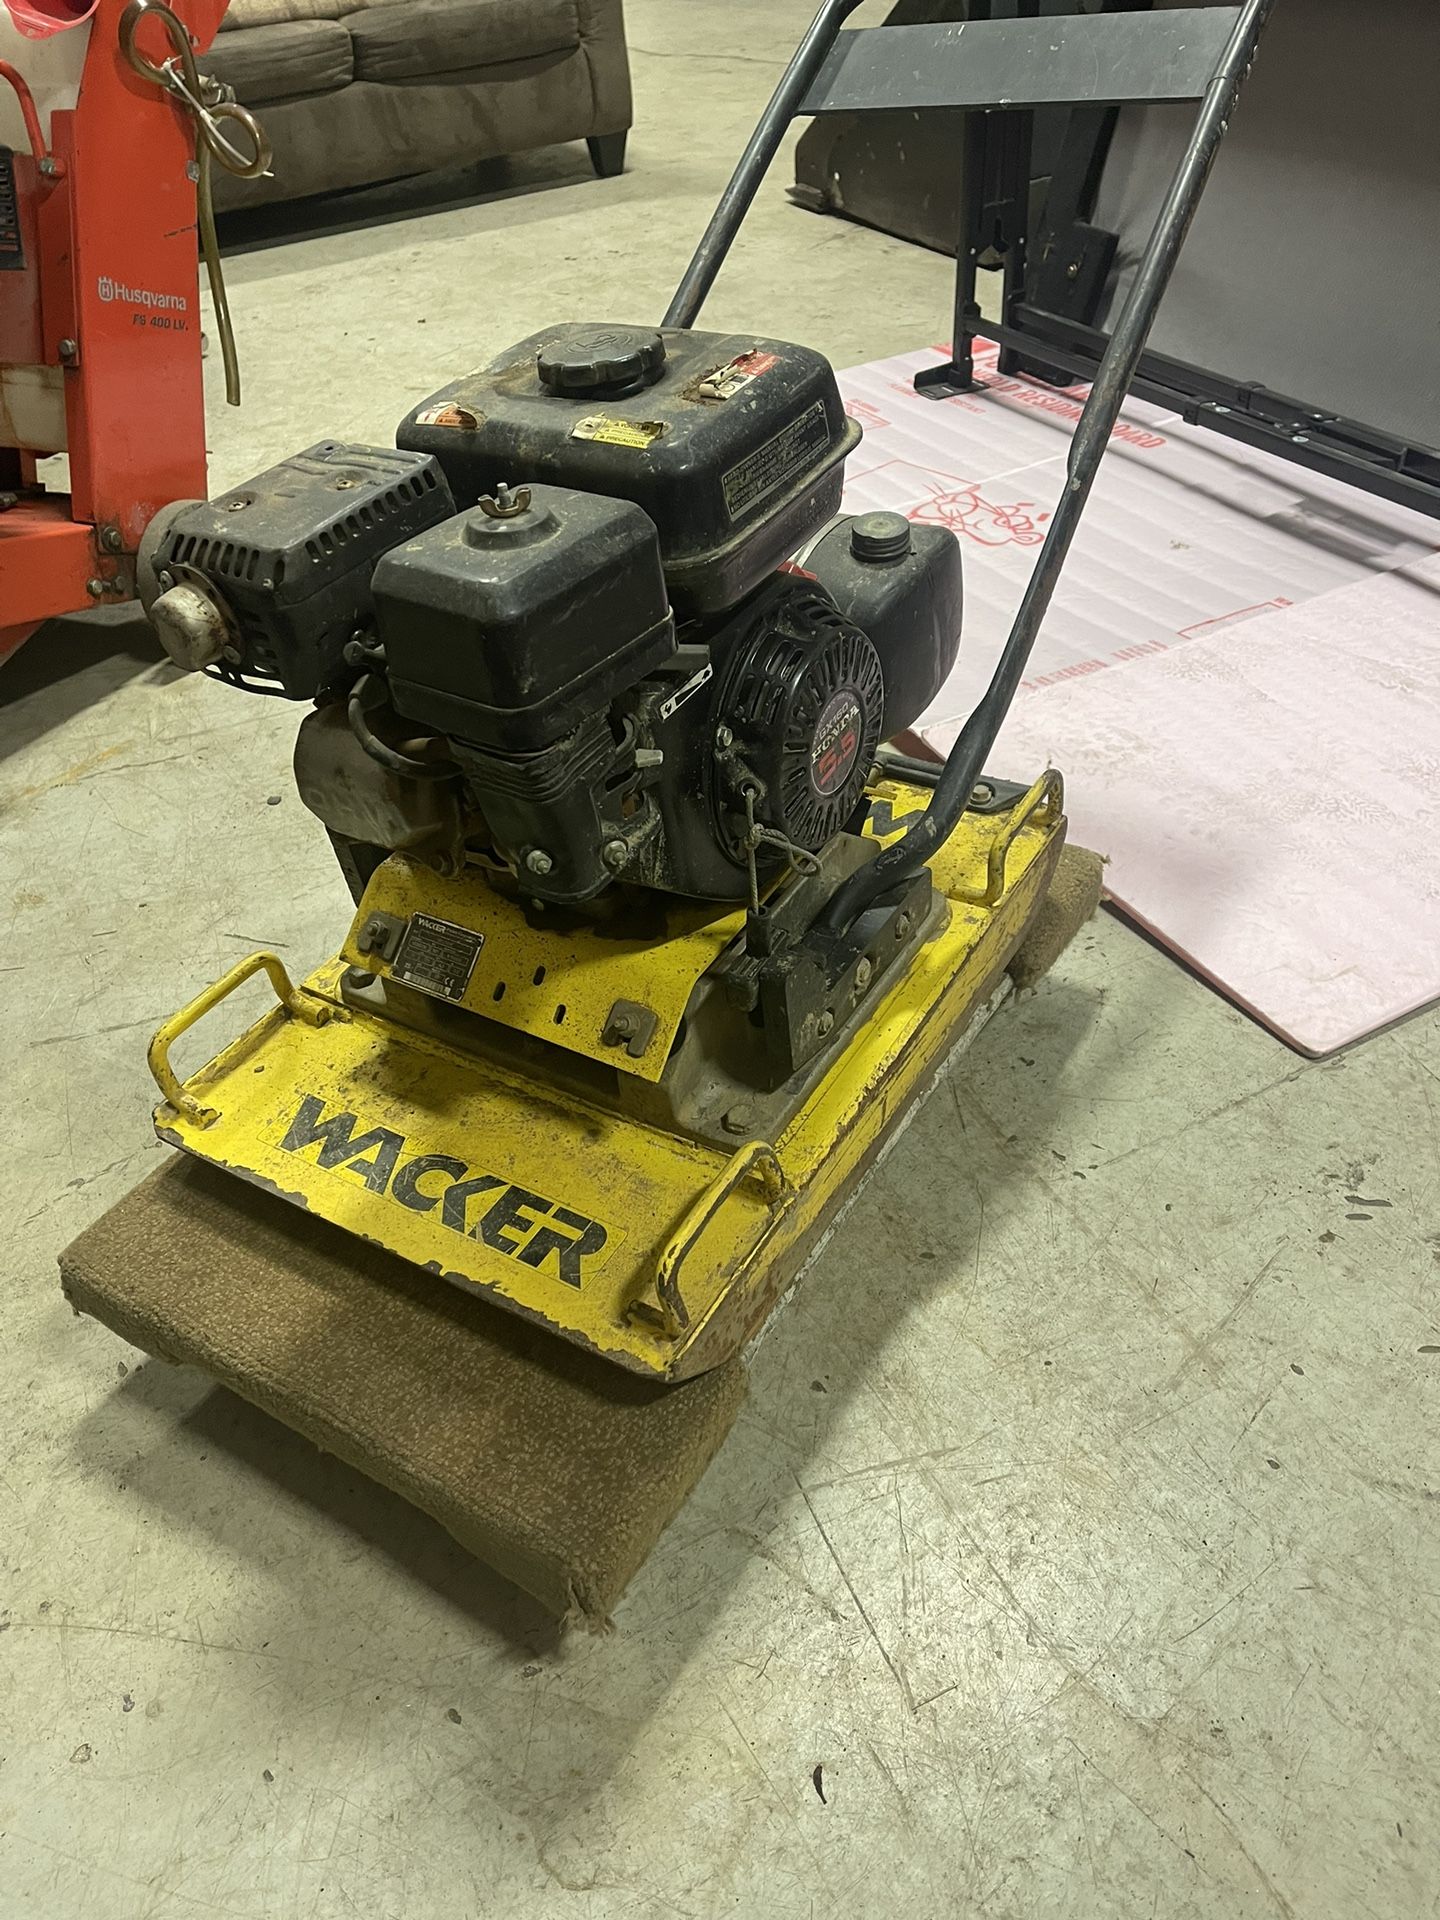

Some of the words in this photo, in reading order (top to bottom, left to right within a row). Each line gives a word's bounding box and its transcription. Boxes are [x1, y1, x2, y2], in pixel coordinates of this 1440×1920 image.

[114, 282, 187, 311] Husqvarna
[150, 316, 171, 329] 400
[1013, 388, 1083, 422] RESIDIN
[1112, 421, 1167, 449] OARD
[606, 435, 645, 446] PRECAUTION
[811, 704, 861, 765] HONDA
[818, 702, 850, 741] GX160
[418, 917, 447, 933] WACKER
[279, 1093, 609, 1292] WACKER
